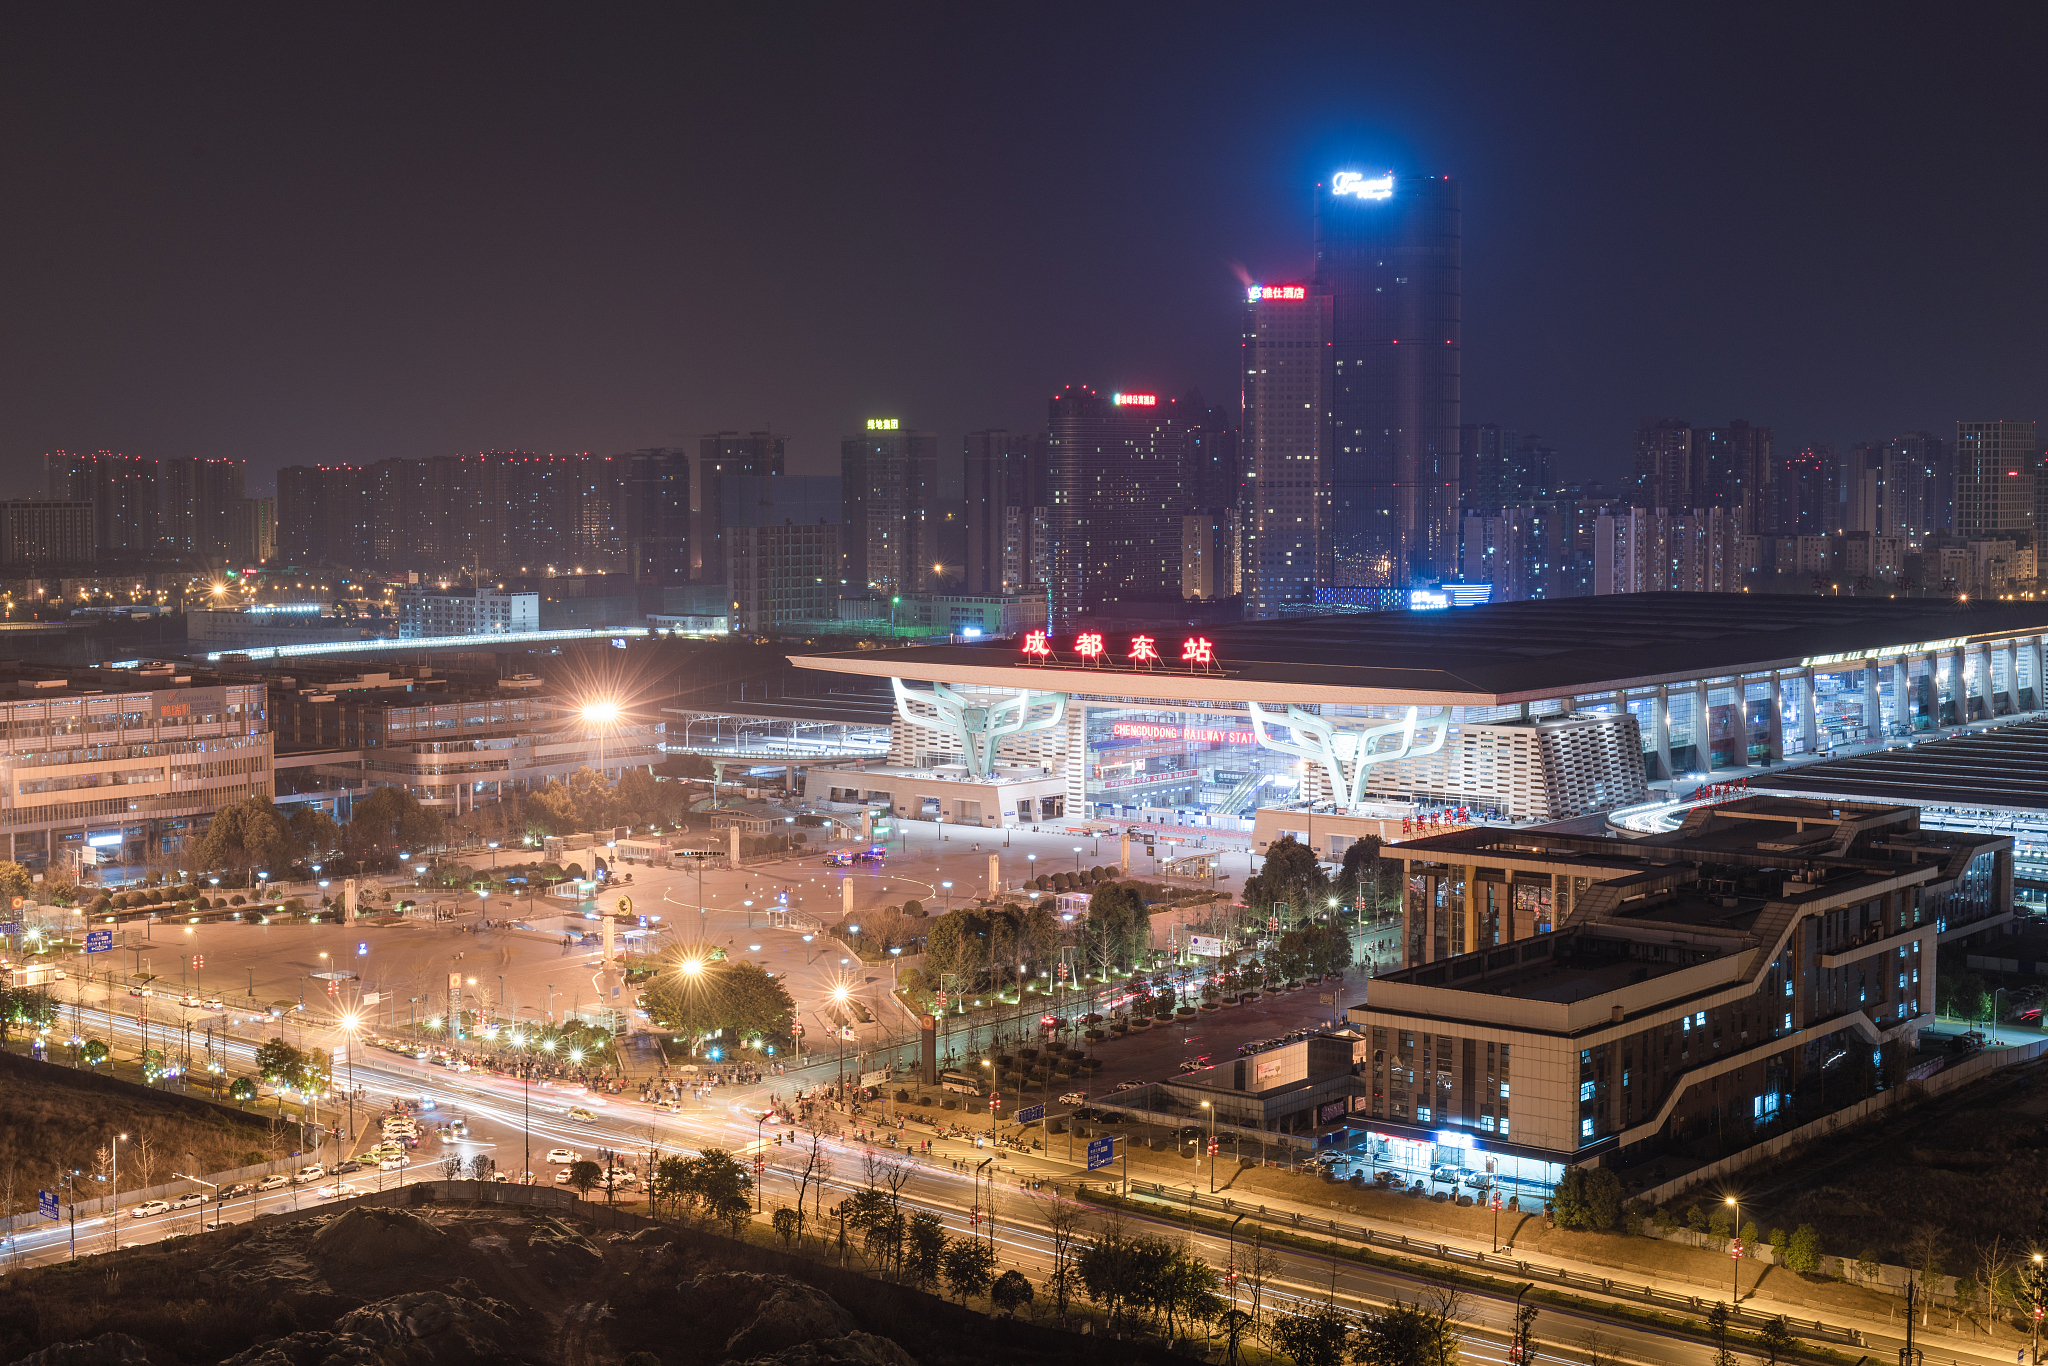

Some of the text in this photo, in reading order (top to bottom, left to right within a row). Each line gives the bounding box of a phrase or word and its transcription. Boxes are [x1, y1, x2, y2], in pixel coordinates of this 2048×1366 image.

[1262, 287, 1305, 299] 雅仕酒店
[867, 419, 899, 430] 绿地集团
[1022, 630, 1212, 662] 成都东站
[160, 703, 190, 717] 鹏瑞利
[1114, 724, 1272, 744] CHENGDUDONG RAILWAY STATI
